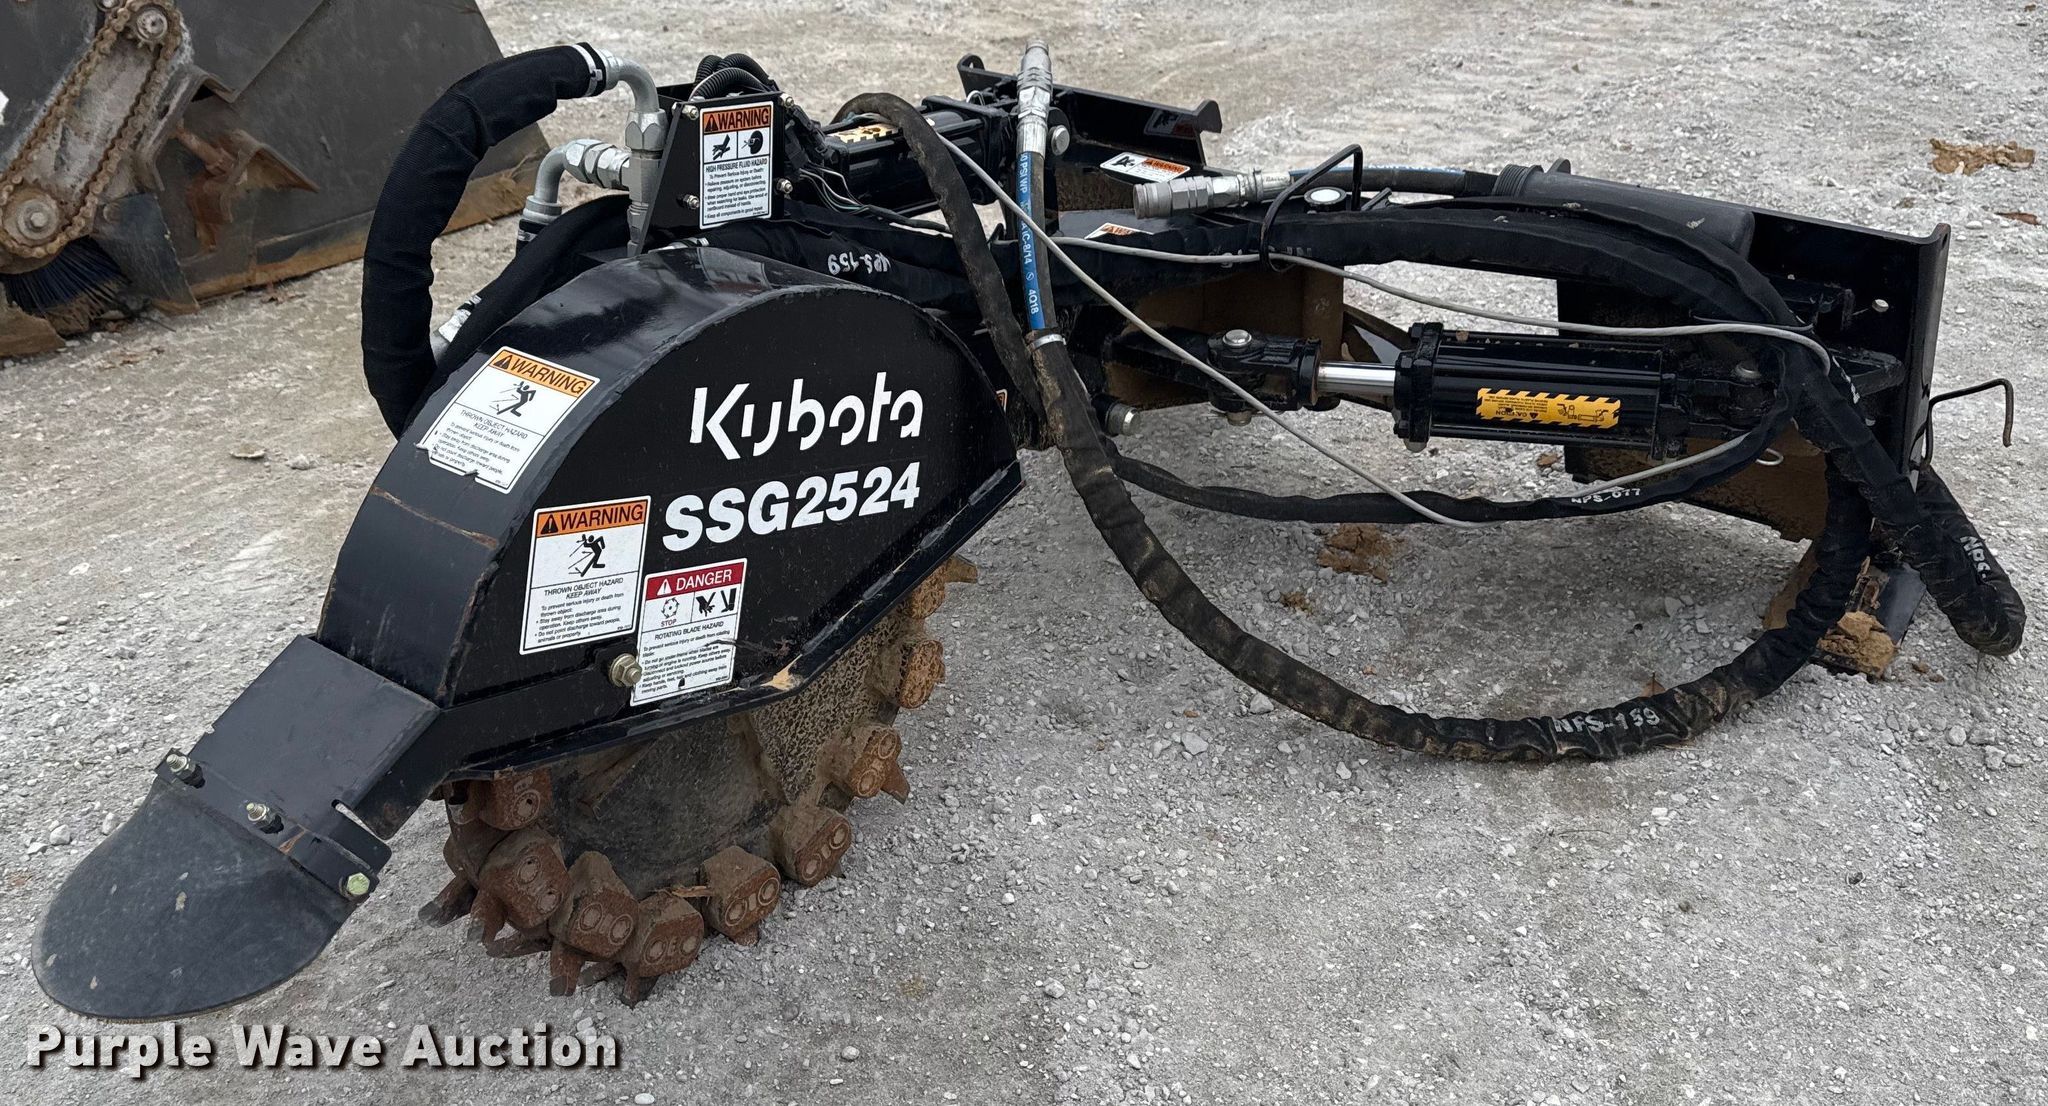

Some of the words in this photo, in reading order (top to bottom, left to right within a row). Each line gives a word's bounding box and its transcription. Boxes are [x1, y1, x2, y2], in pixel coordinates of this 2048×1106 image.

[718, 108, 769, 129] WARNING
[717, 162, 738, 171] PRESSURE
[739, 160, 750, 169] FLUID
[751, 158, 767, 166] HAZARD
[1019, 162, 1028, 177] PSI
[1019, 179, 1028, 193] WP
[1027, 289, 1039, 314] 4Q18
[510, 356, 587, 394] WARNING
[461, 409, 483, 423] THROWN
[484, 418, 505, 430] OBJECT
[505, 426, 528, 439] HAZARD
[690, 372, 923, 460] Kubota
[560, 504, 643, 530] WARNING
[662, 462, 920, 552] SSG2524
[544, 587, 572, 596] THROWN
[573, 582, 598, 592] OBJECT
[599, 578, 624, 587] HAZARD
[676, 569, 732, 591] DANGER
[566, 591, 583, 599] KEEP
[583, 588, 602, 596] AWAY
[655, 630, 682, 640] ROTATING
[683, 626, 701, 634] BLADE
[702, 621, 724, 630] HAZARD
[660, 618, 677, 627] STOP
